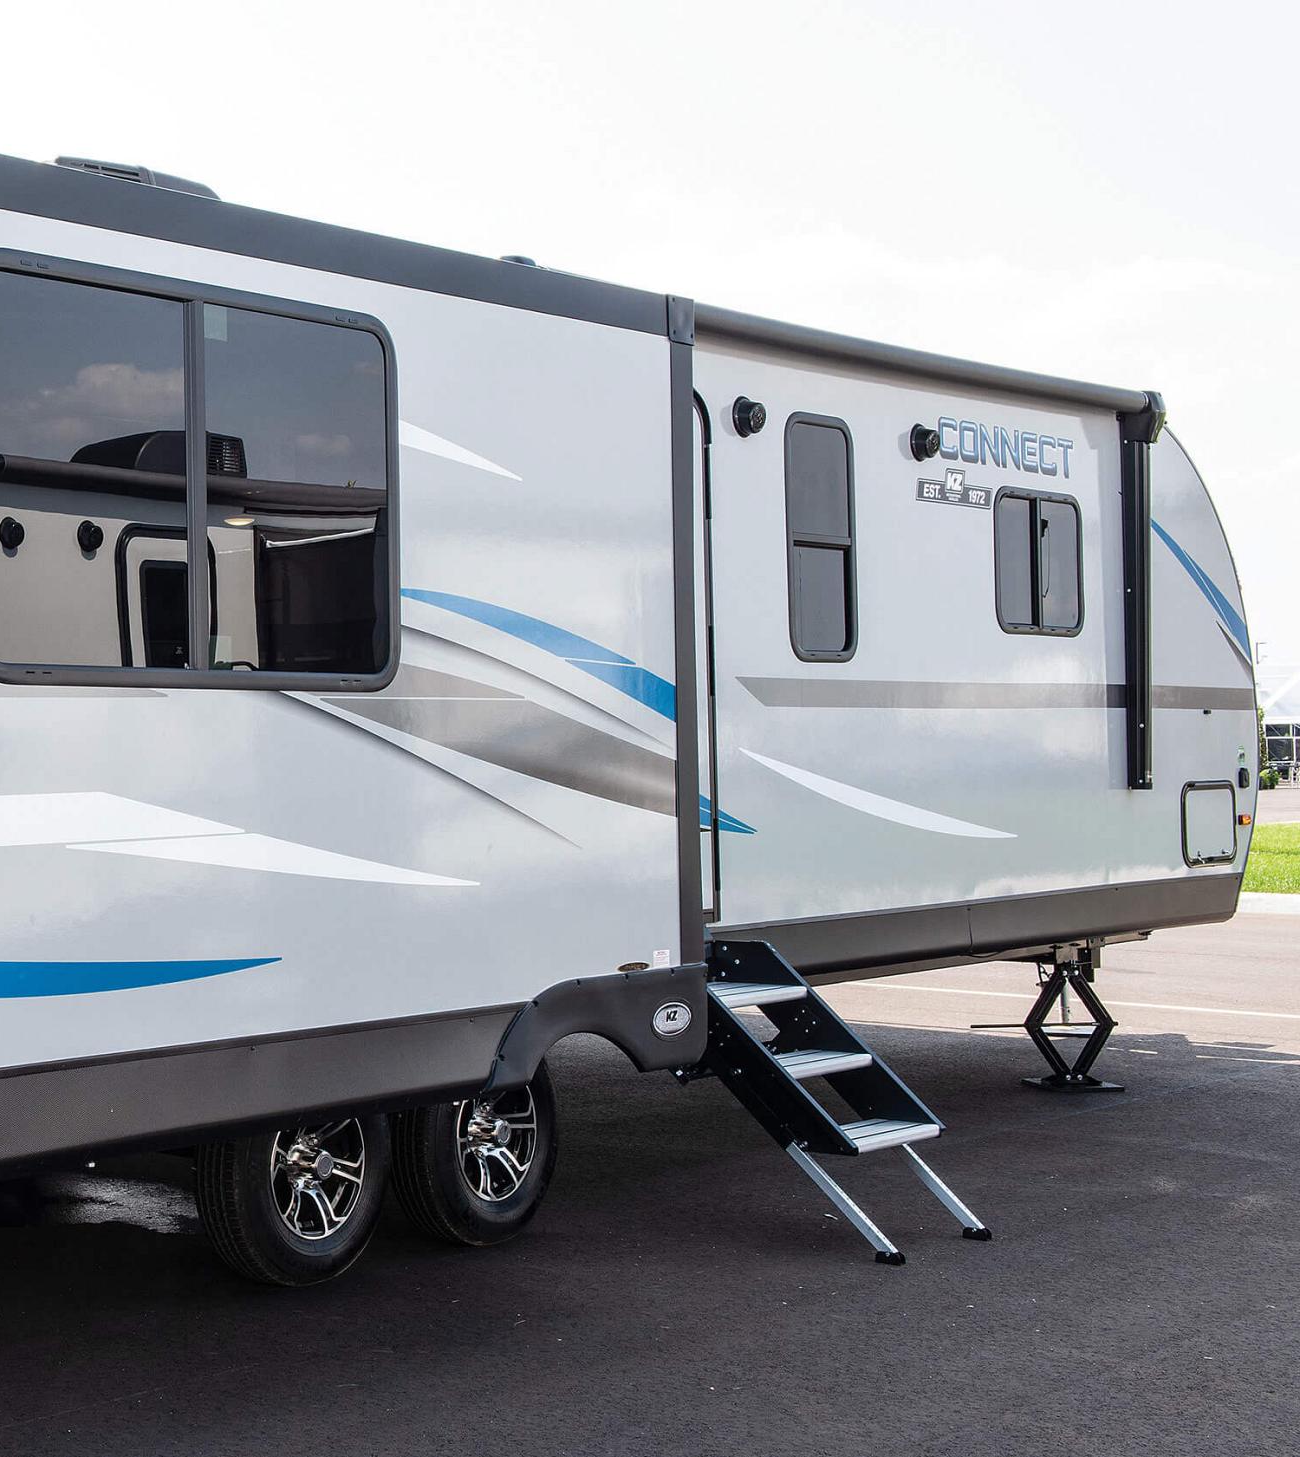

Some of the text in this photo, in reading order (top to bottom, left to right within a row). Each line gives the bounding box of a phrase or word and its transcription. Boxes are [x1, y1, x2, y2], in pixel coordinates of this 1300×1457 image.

[938, 416, 1074, 479] CONNECT
[947, 472, 963, 491] KZ
[923, 483, 942, 499] EST.
[968, 489, 986, 505] 1972
[665, 1009, 679, 1023] KZ
